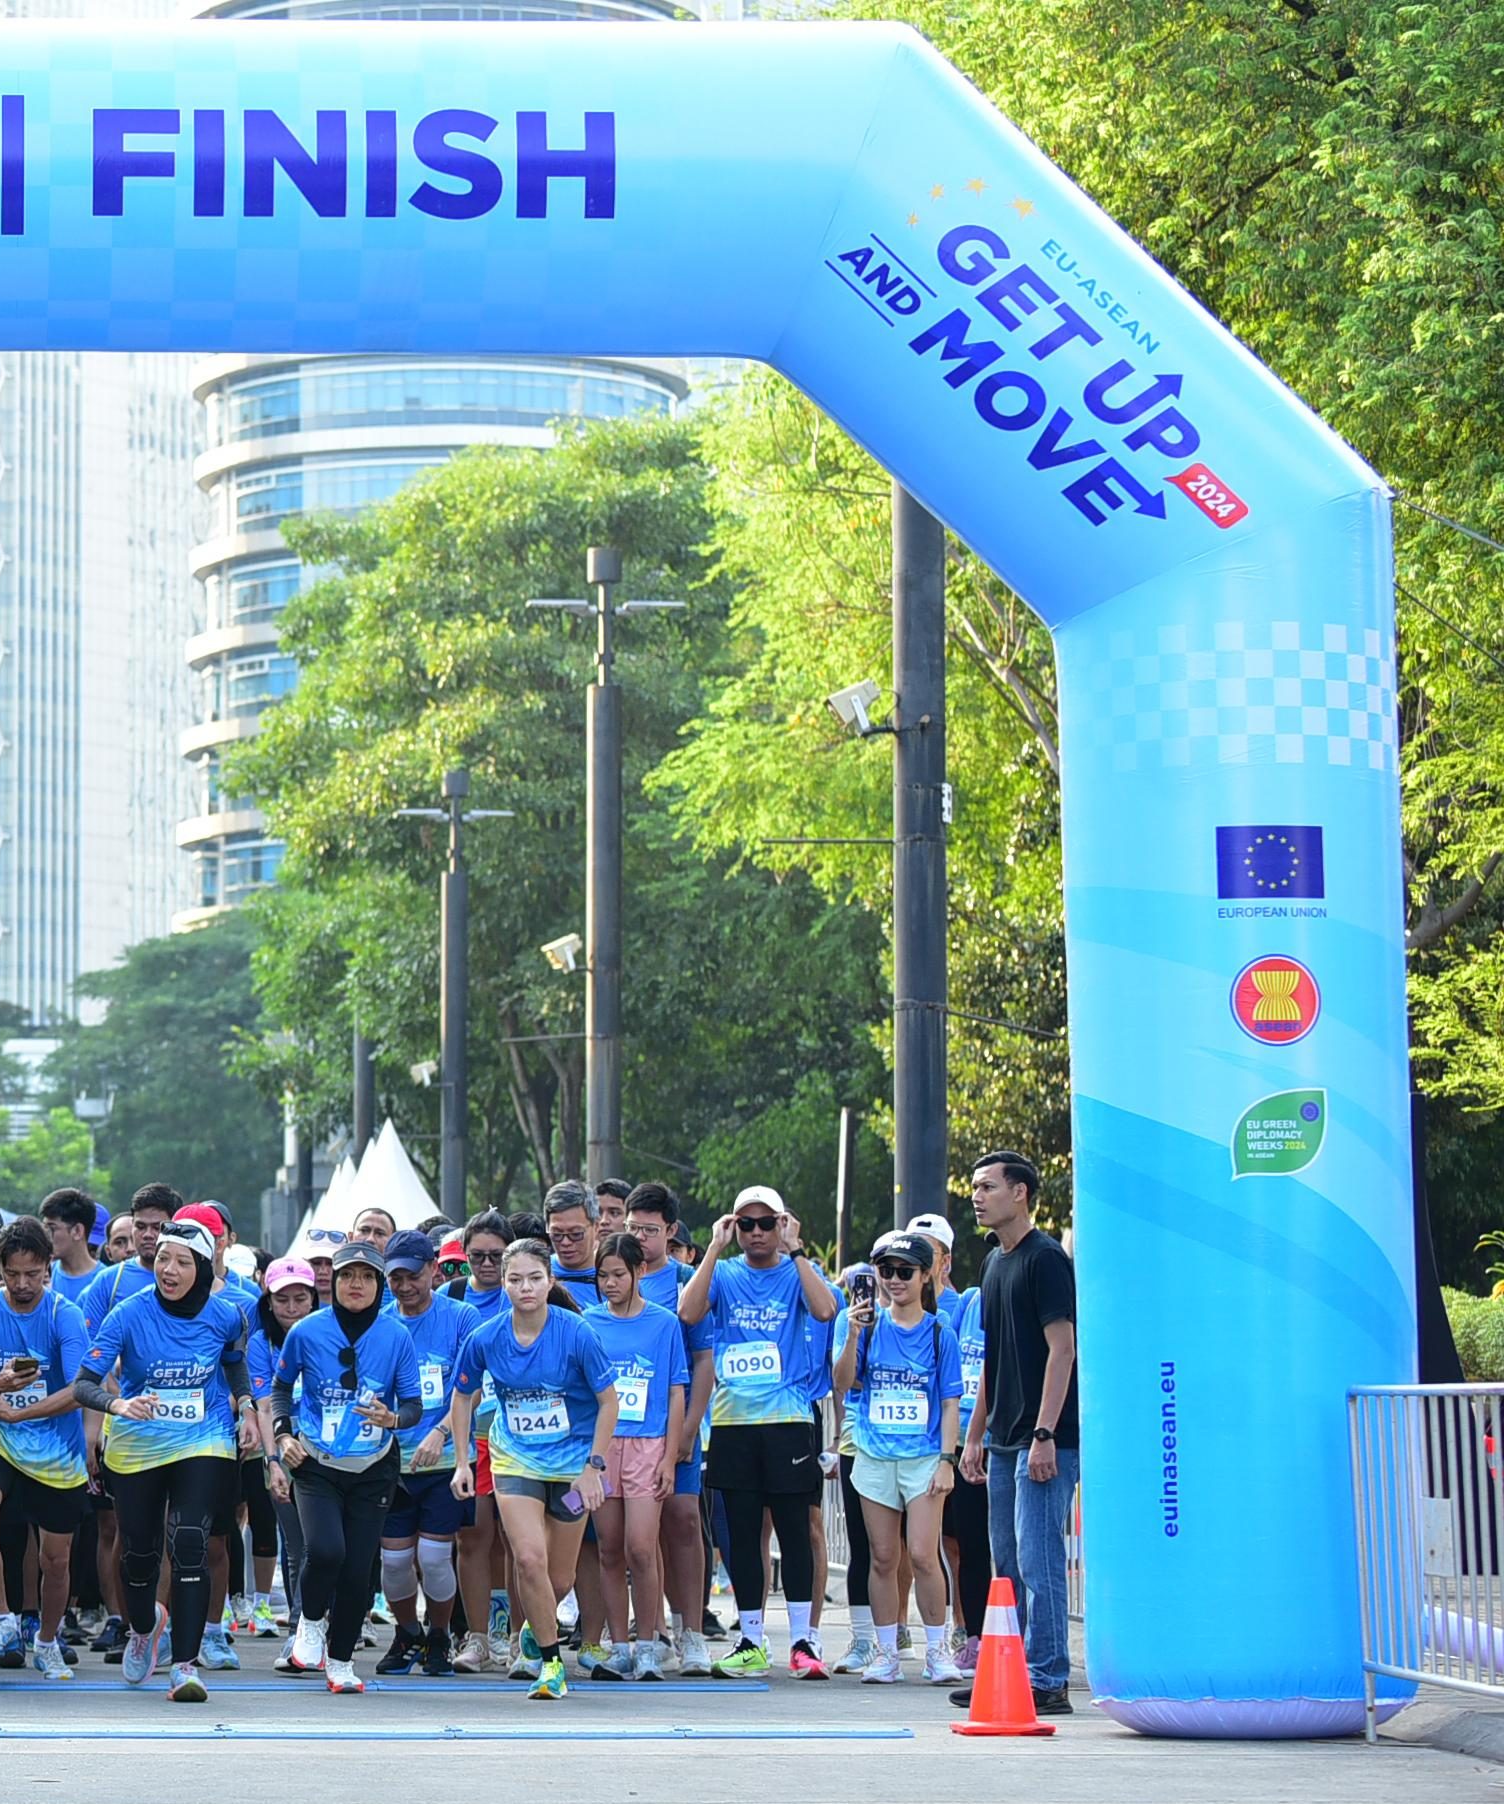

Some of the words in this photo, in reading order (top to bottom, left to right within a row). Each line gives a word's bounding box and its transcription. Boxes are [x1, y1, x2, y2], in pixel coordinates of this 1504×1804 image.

[92, 108, 616, 220] FINISH
[1040, 238, 1161, 355] EU-ASEAN
[936, 224, 1104, 362] GET
[1082, 358, 1202, 459] UP
[837, 246, 922, 316] AND
[907, 307, 1166, 528] MOVE
[1185, 473, 1237, 519] 2024
[1217, 907, 1288, 919] EUROPEAN
[1290, 906, 1328, 918] UNION
[1254, 1021, 1302, 1032] asean
[1246, 1120, 1260, 1129] EU
[1262, 1120, 1297, 1129] GREEN
[1246, 1130, 1303, 1140] DIPLOMACY
[1246, 1141, 1284, 1151] WEEKS
[1284, 1141, 1307, 1150] 2024
[734, 1307, 759, 1319] GET
[760, 1306, 778, 1321] UP
[739, 1319, 779, 1332] MOVE
[960, 1342, 985, 1356] GET
[153, 1367, 184, 1379] GET
[185, 1362, 206, 1378] UP
[626, 1362, 645, 1377] UP
[728, 1355, 775, 1374] 1090
[160, 1376, 205, 1387] MOVE
[872, 1370, 899, 1382] GET
[900, 1370, 920, 1383] UP
[322, 1387, 353, 1399] GET
[616, 1391, 638, 1407] 70
[3, 1393, 40, 1409] 389
[878, 1405, 918, 1420] 1133
[513, 1414, 561, 1432] 1244
[1159, 1361, 1179, 1538] euinasean.eu
